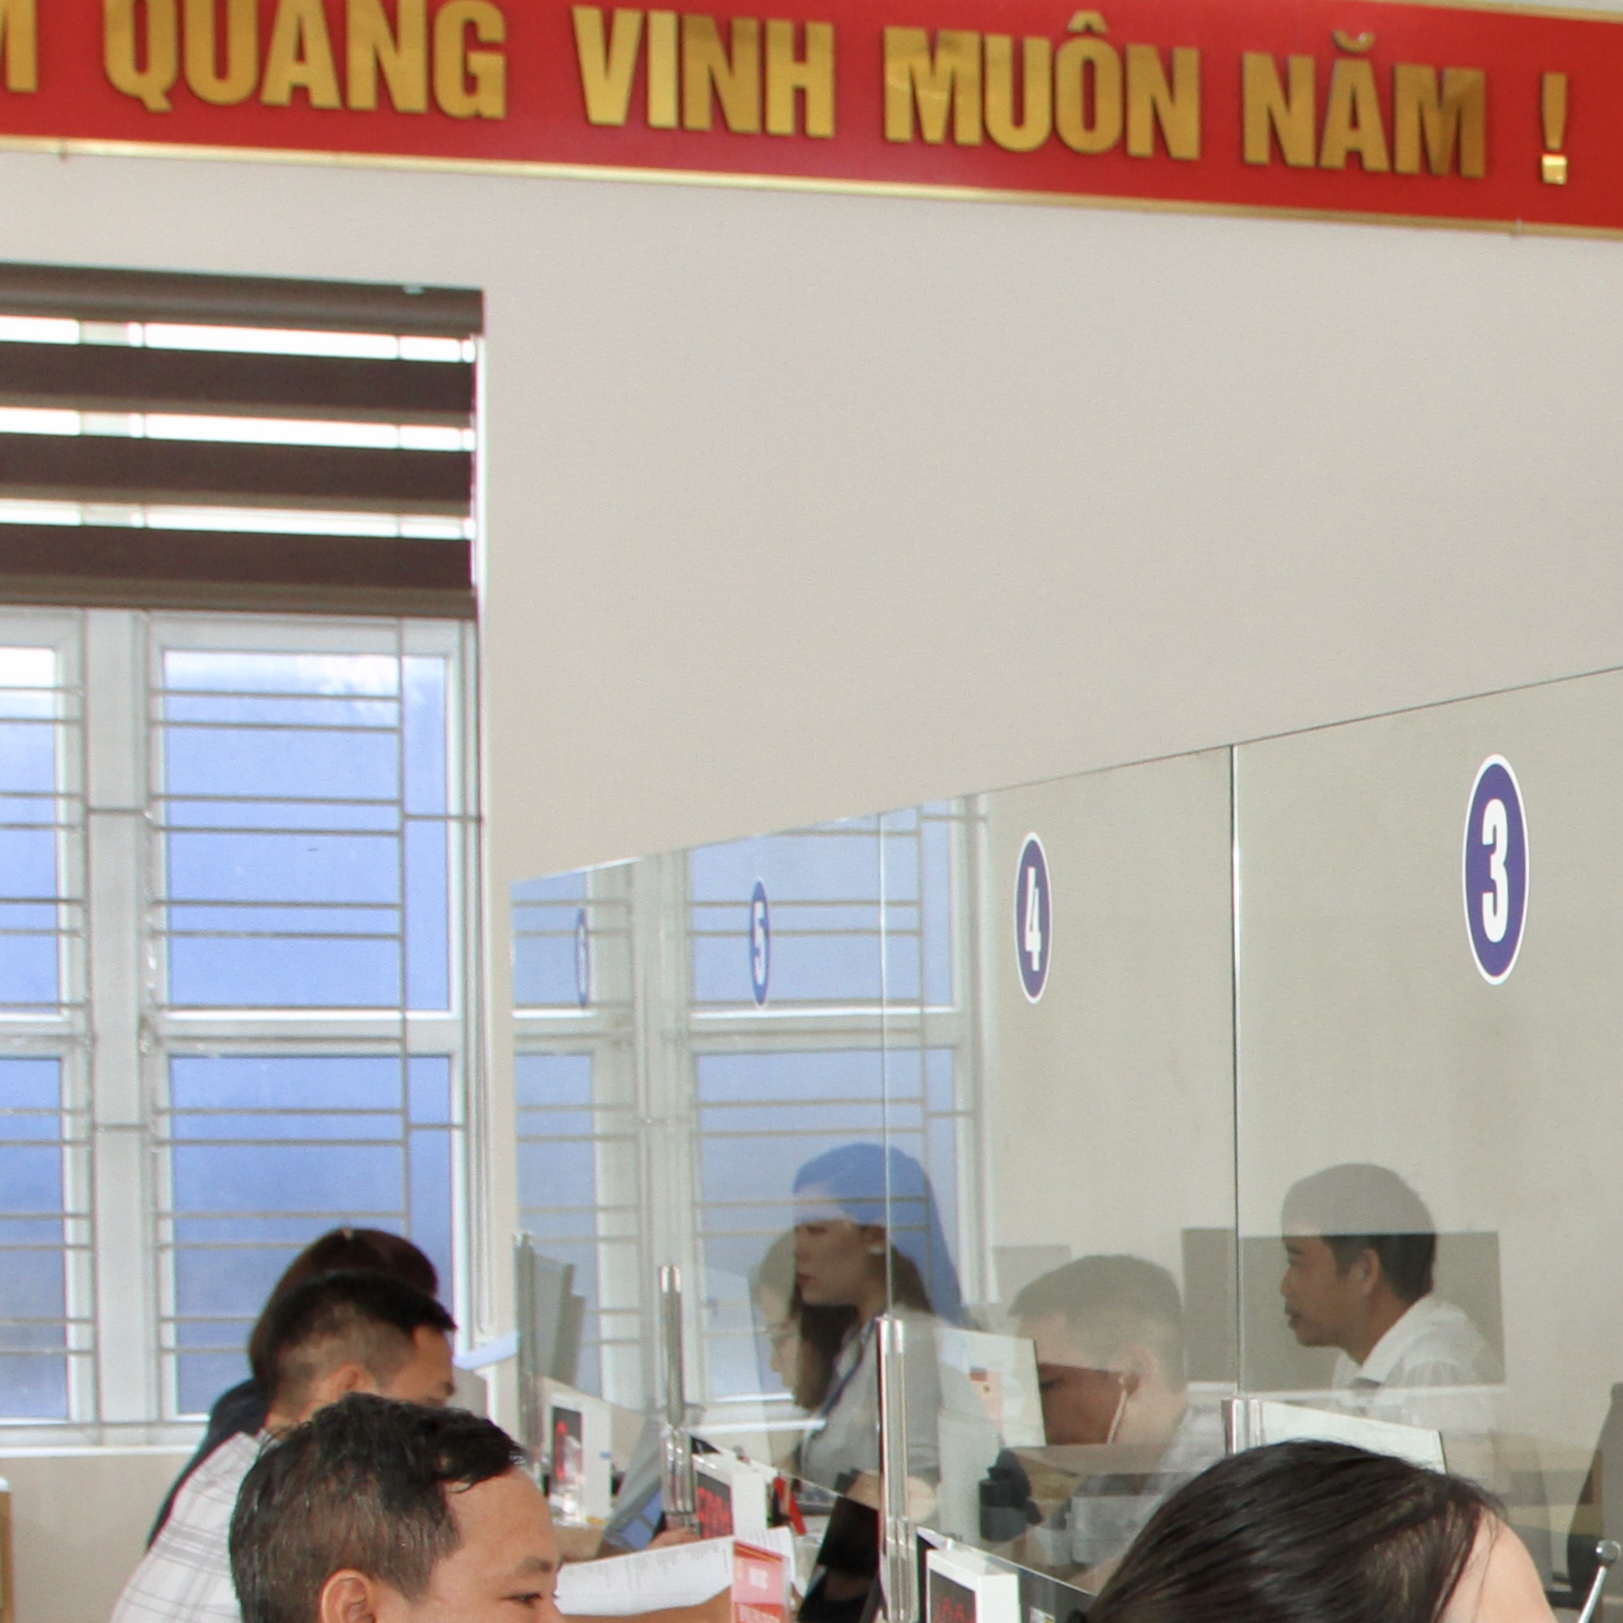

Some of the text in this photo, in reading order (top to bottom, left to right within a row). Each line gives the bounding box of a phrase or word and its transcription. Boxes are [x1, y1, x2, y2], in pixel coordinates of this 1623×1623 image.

[103, 0, 507, 120] QUANG
[572, 5, 837, 138] VINH
[883, 10, 1201, 162] MUÔN
[1242, 29, 1487, 180] NĂM
[1023, 867, 1043, 970] 4
[1480, 797, 1511, 944] 3
[753, 900, 766, 986] 5
